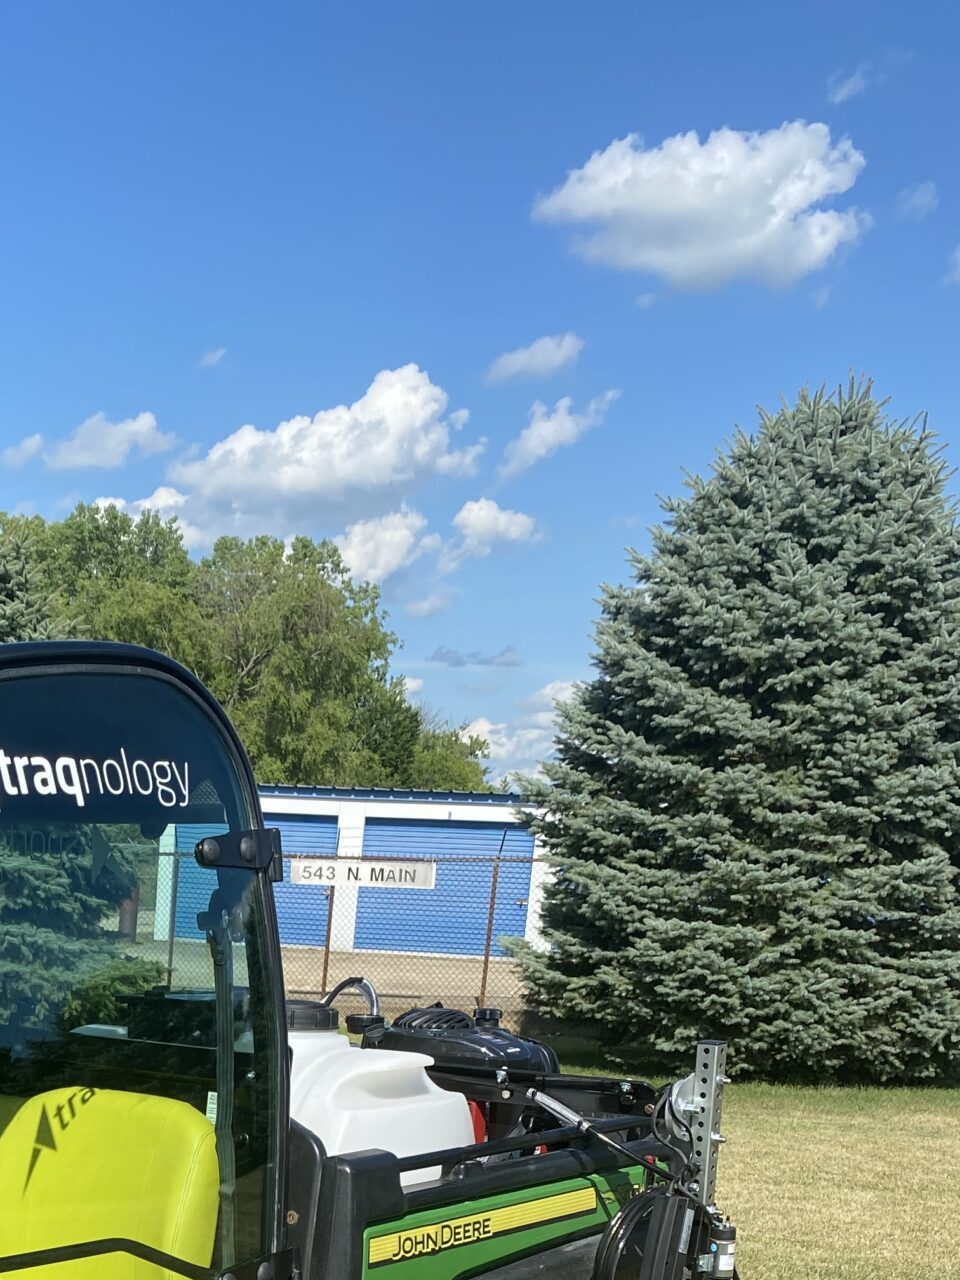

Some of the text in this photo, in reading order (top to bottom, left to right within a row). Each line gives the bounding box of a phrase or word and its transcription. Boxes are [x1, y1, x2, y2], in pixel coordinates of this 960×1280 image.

[302, 866, 417, 883] 543 N. MAIN
